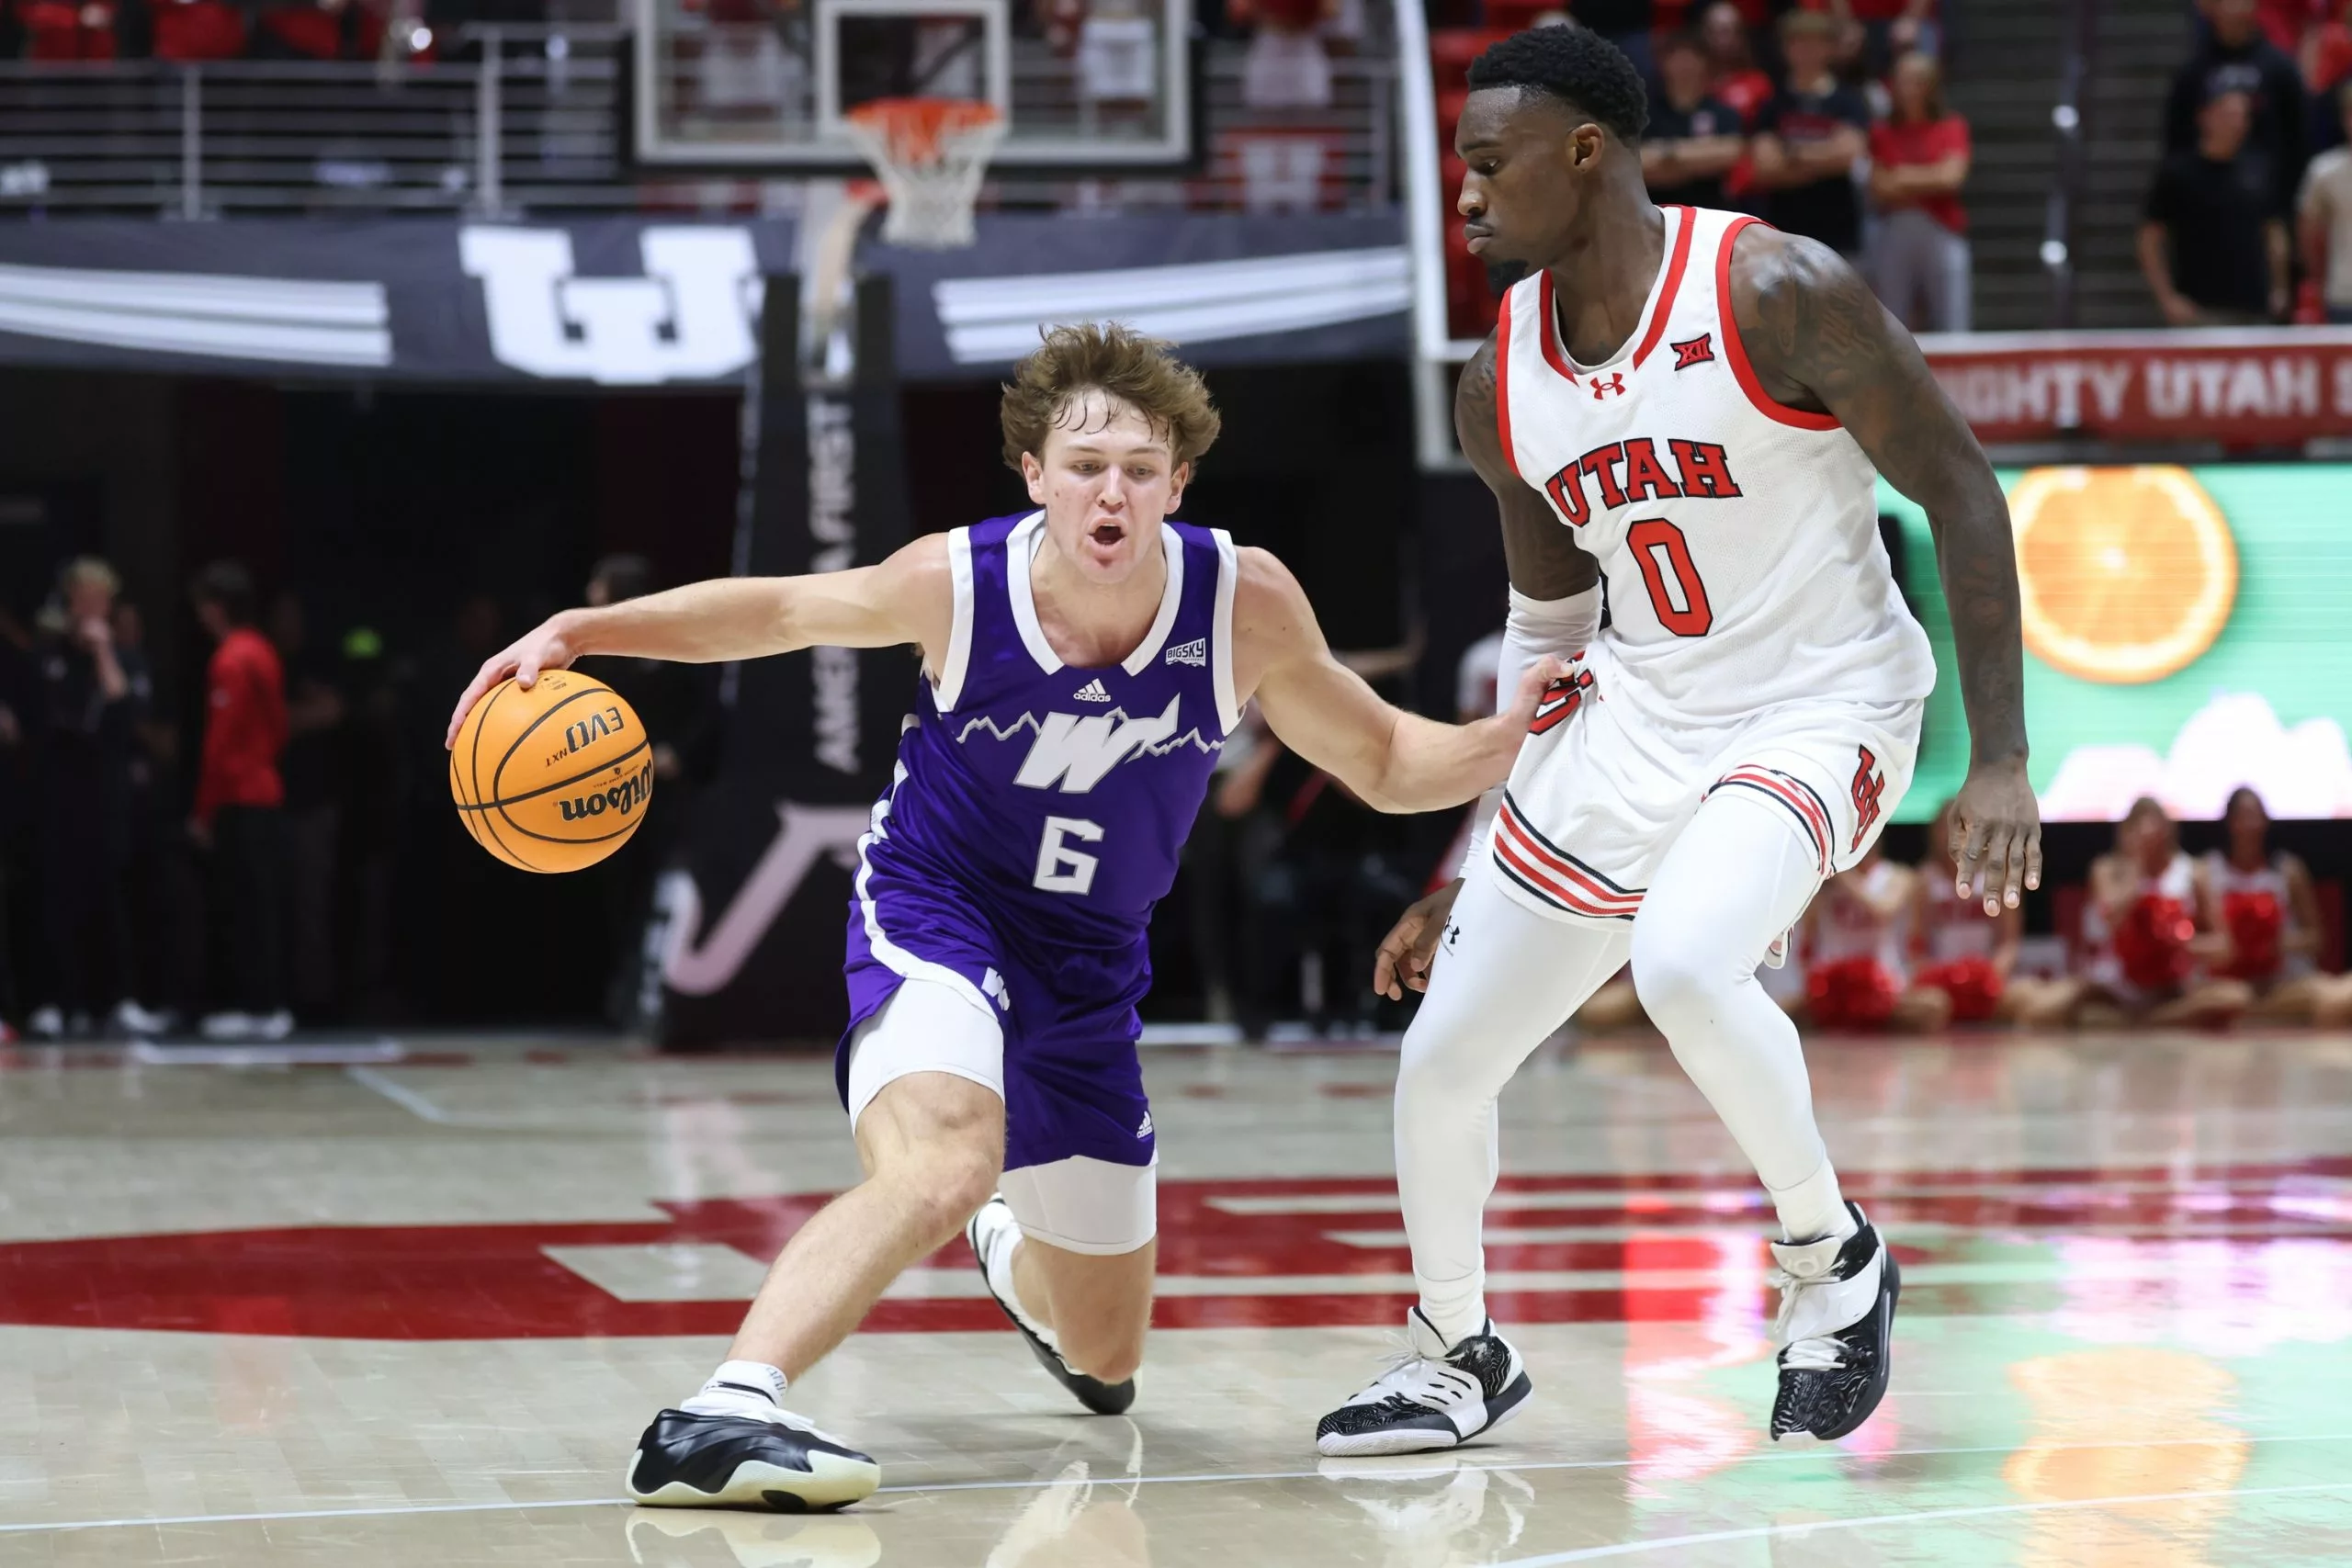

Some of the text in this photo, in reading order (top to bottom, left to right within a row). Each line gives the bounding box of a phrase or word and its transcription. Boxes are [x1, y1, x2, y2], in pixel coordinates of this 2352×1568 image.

[1935, 359, 2133, 423] IGHTY
[2146, 355, 2322, 420] UTAH
[806, 402, 856, 543] FIRST
[1544, 437, 1744, 528] UTAH
[1625, 517, 1713, 637] 0
[1073, 692, 1112, 703] adidas
[546, 748, 569, 767] NXT
[559, 759, 653, 821] Wilson
[1032, 816, 1105, 896] 6
